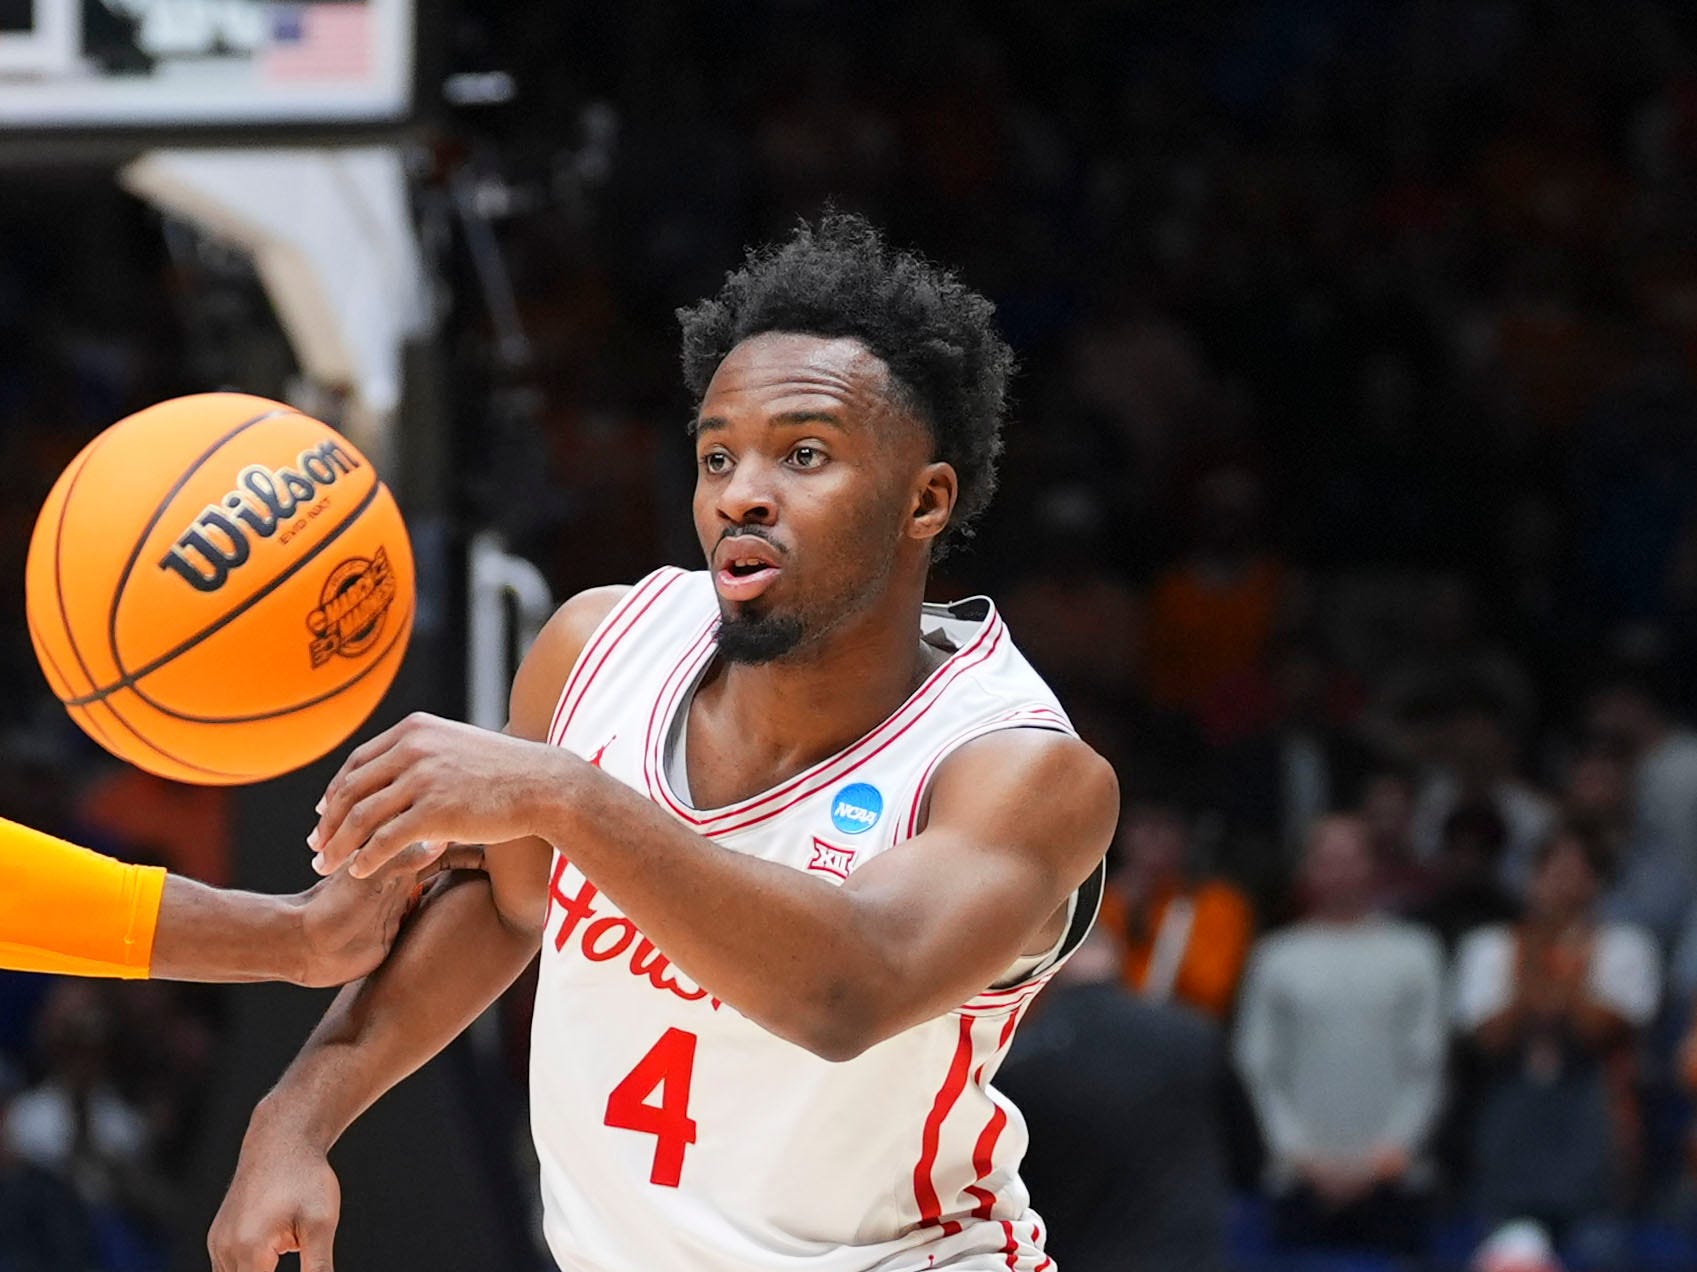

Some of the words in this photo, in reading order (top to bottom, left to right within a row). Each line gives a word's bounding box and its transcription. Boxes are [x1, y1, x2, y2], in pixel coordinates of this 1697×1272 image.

[158, 439, 360, 593] Wilson
[834, 801, 878, 826] NCAA
[604, 1026, 697, 1189] 4
